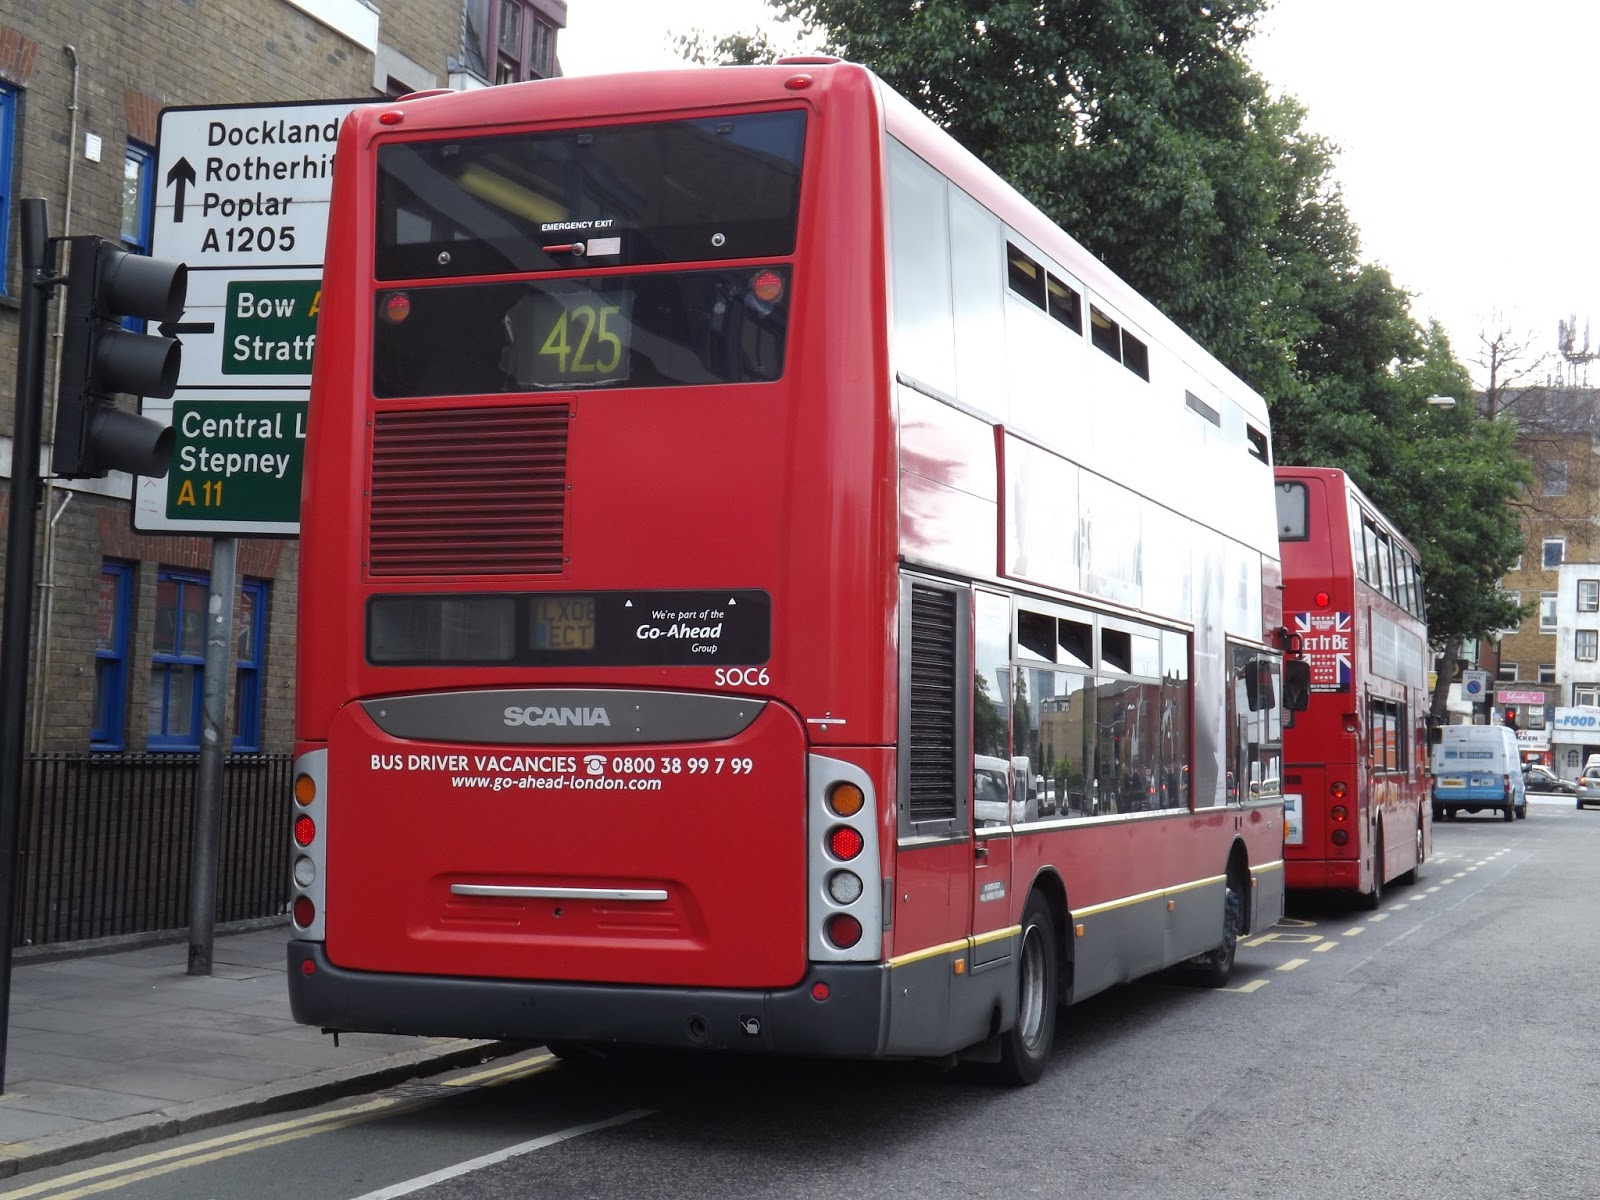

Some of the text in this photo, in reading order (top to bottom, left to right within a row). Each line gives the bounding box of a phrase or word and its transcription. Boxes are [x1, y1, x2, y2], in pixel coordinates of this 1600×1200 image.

[207, 118, 339, 147] Dockland
[205, 154, 336, 182] Rotherhit
[203, 192, 293, 221] Poplar
[541, 219, 613, 231] EMERGENCY EXIT
[201, 226, 295, 253] A1205
[237, 292, 295, 318] Bow
[232, 334, 316, 361] Stratf
[539, 305, 622, 374] 425
[181, 411, 283, 439] Central
[179, 445, 290, 479] Stepney
[652, 609, 725, 622] We're part of the
[636, 623, 722, 639] Go-Ahead
[691, 643, 718, 655] Group
[714, 668, 770, 687] SOC6
[503, 707, 611, 727] SCANIA
[1563, 715, 1596, 727] FOOD
[370, 754, 753, 775] BUS DRIVER VACANCIES 0800 38 99 7 99
[451, 774, 662, 792] www.go-ahead-london.com
